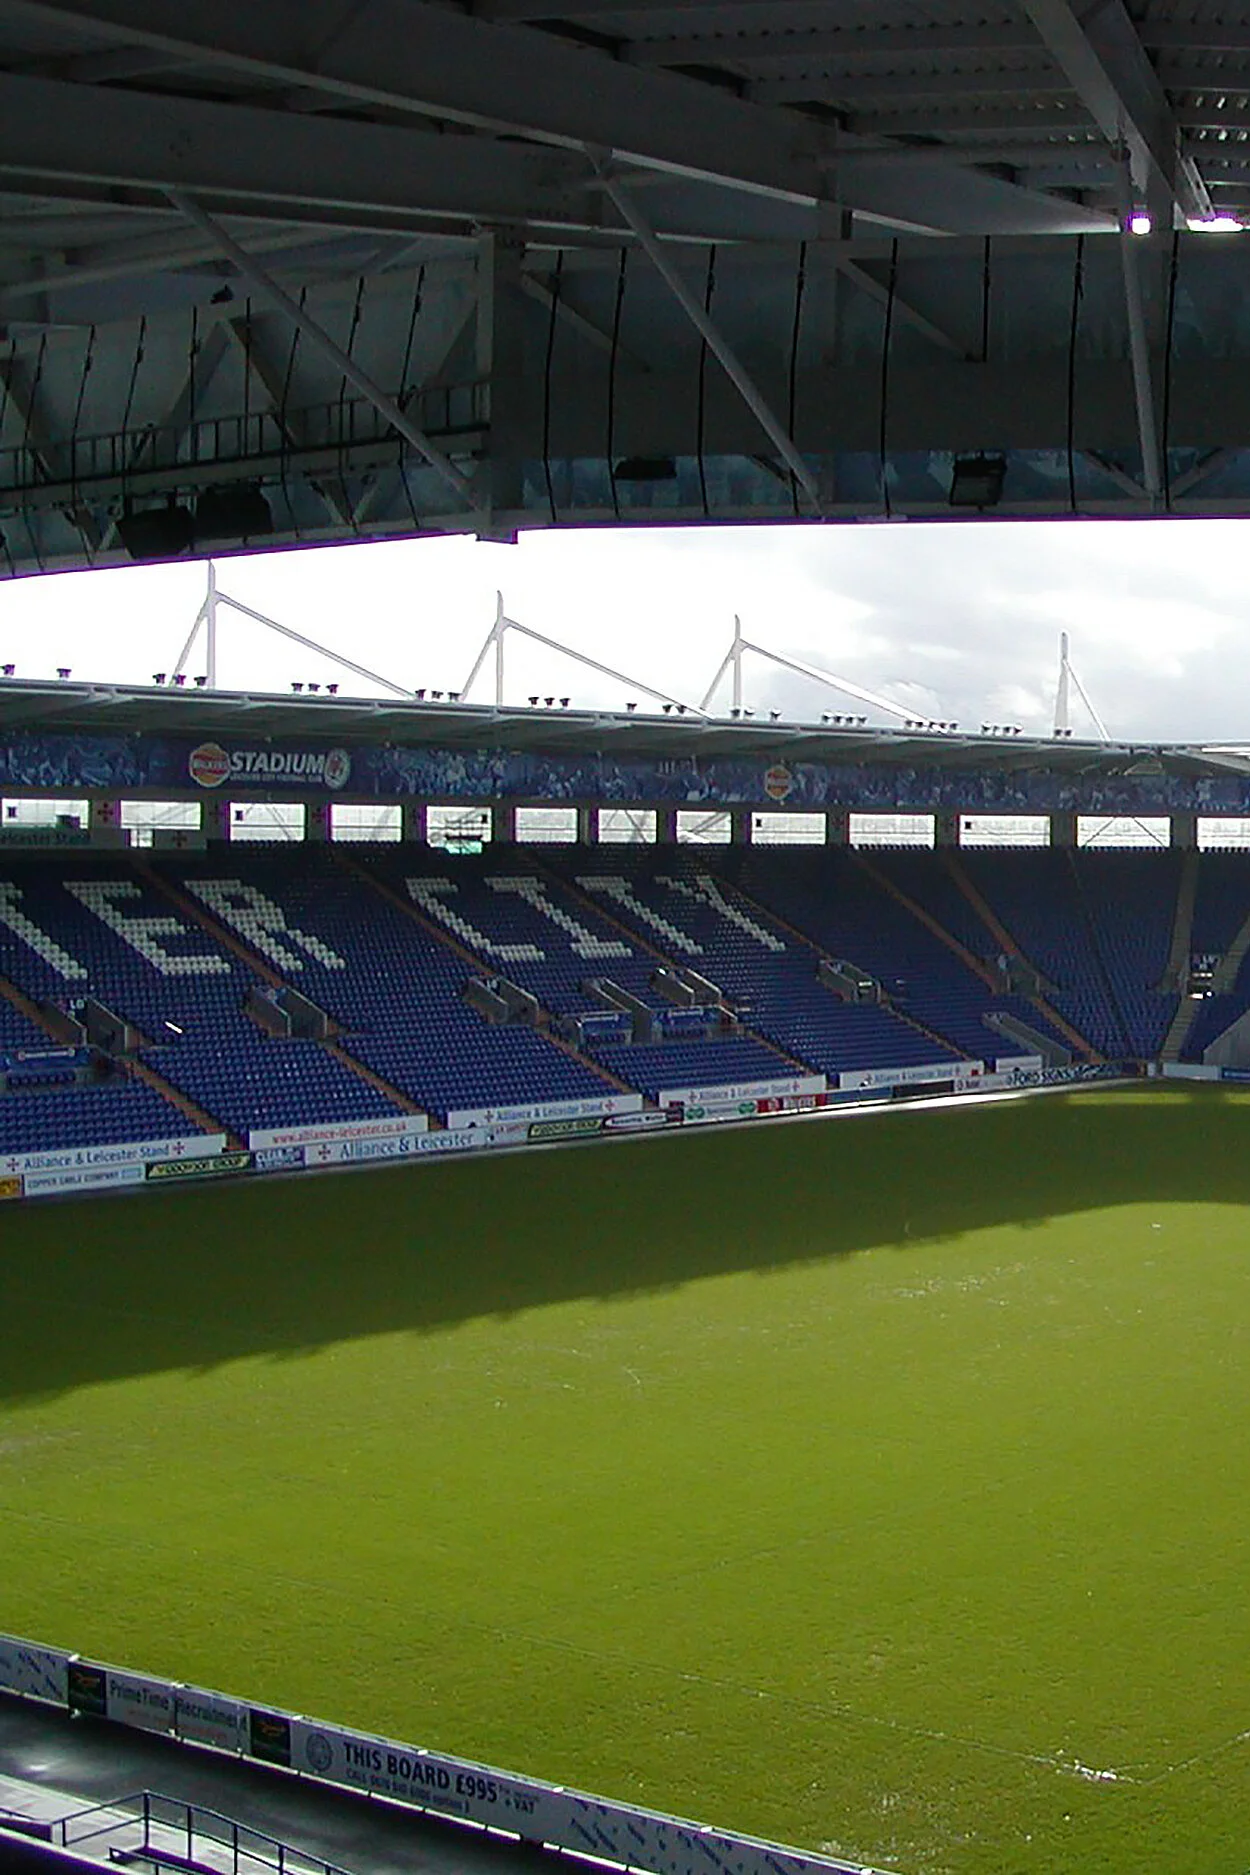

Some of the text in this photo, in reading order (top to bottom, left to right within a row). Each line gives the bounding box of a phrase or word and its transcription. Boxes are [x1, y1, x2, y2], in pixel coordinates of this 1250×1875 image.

[231, 751, 325, 774] STADIUM
[24, 1144, 169, 1170] Alliance & Leicester Stand
[340, 1131, 474, 1160] Alliance & Leicester
[343, 1741, 382, 1771] THIS
[387, 1754, 450, 1790] BOARD
[456, 1773, 499, 1804] £995
